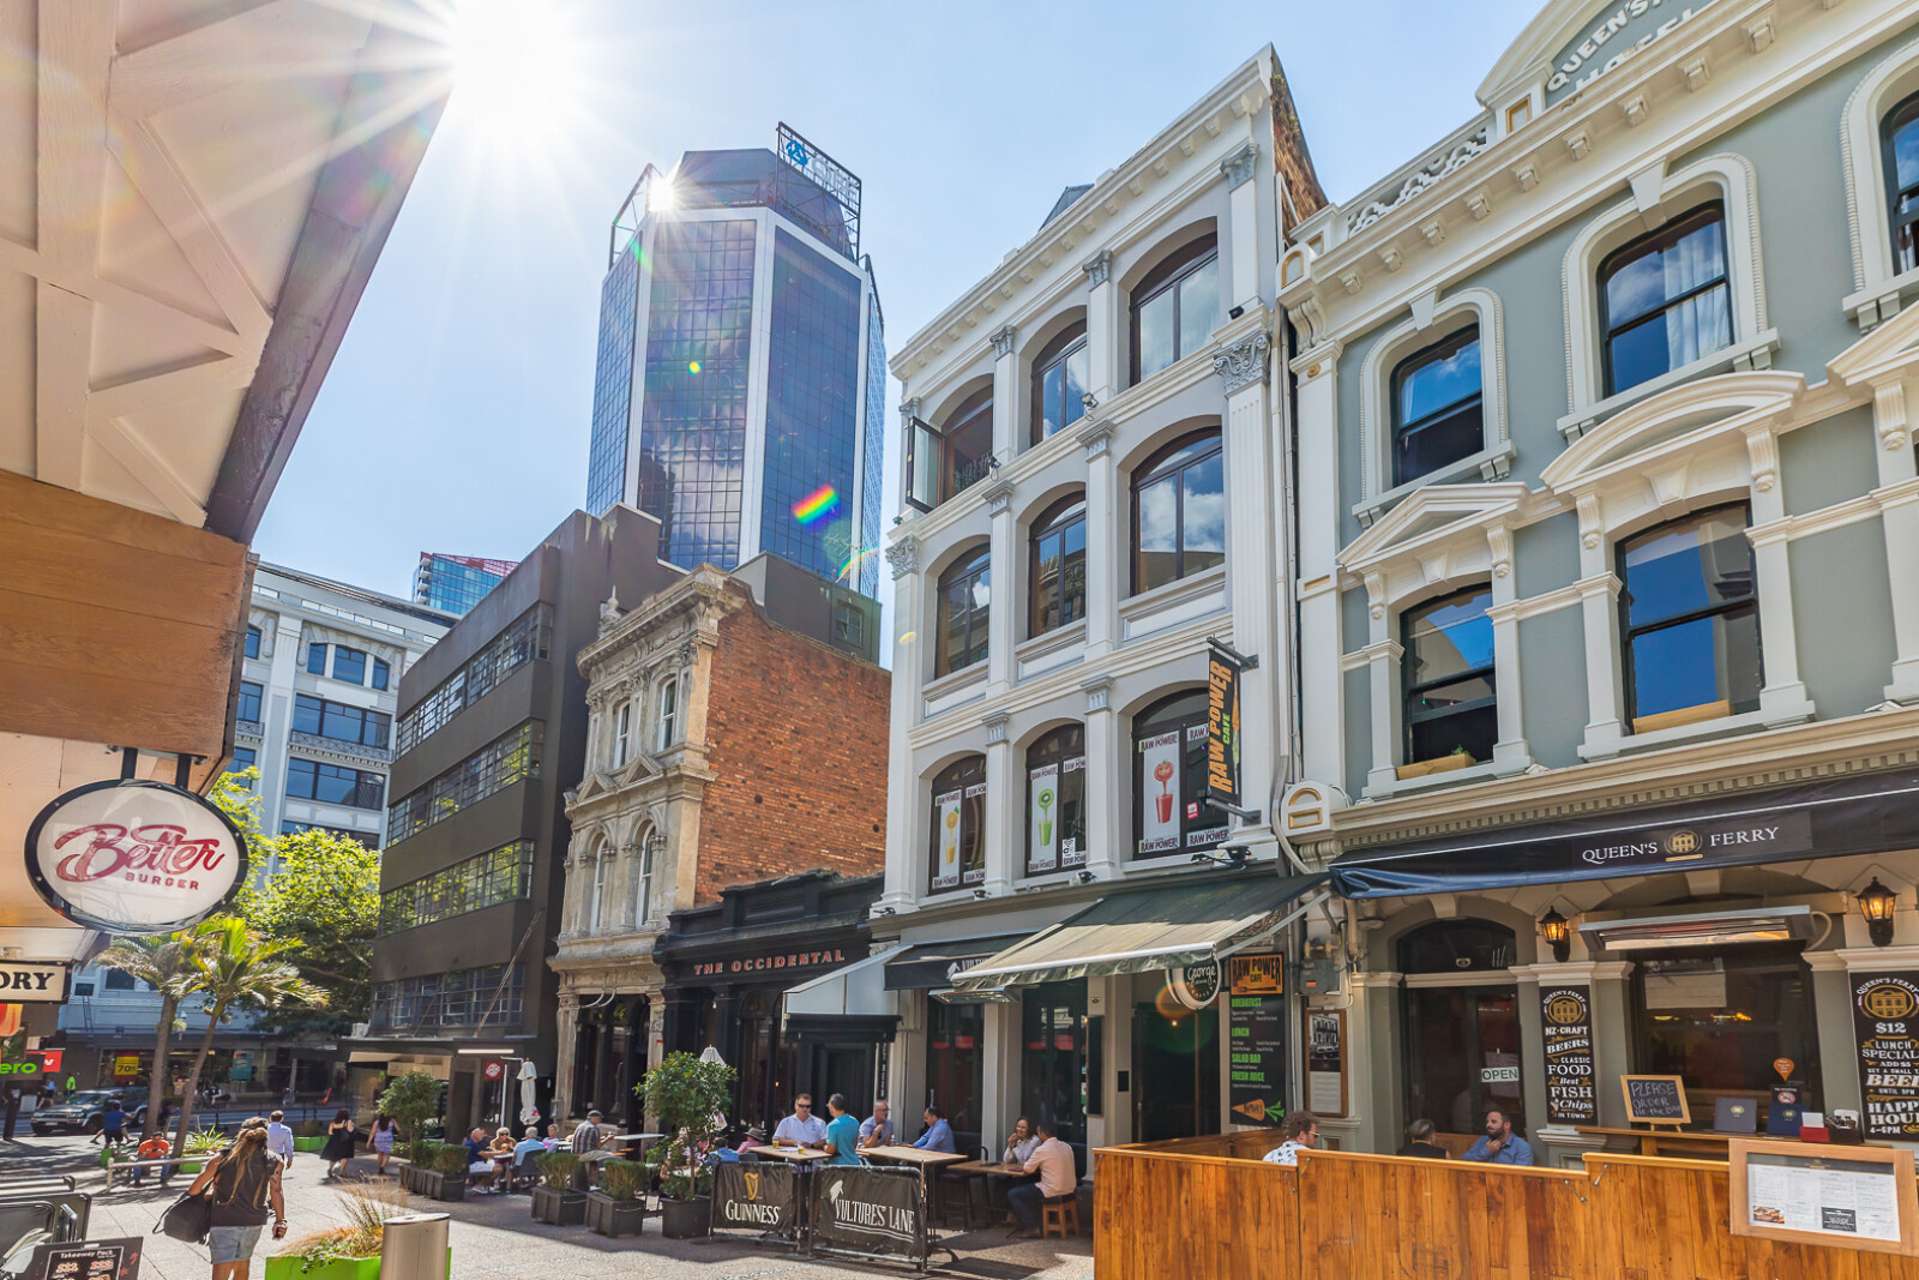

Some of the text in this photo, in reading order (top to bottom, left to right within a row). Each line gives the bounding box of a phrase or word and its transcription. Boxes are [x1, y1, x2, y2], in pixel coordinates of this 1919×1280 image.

[1547, 0, 1651, 92] QUEEN'S
[1190, 726, 1206, 740] RAW
[1209, 660, 1233, 793] RAW POWER
[1222, 713, 1231, 745] CAFE
[1190, 834, 1205, 845] RAW
[1582, 826, 1779, 865] QUEEN'S FERRY
[54, 823, 225, 882] Better
[125, 872, 199, 890] BURGER
[694, 949, 845, 976] THE OCCIDENTAL
[1546, 1039, 1590, 1054] BEERS
[1875, 1040, 1912, 1050] LUNCH
[1482, 1069, 1519, 1081] OPEN
[1547, 1064, 1592, 1076] FOOD
[1550, 1086, 1593, 1098] FISH
[1630, 1081, 1675, 1096] PLEASE
[1559, 1099, 1593, 1111] Chips
[1867, 1101, 1919, 1113] HAPP
[1869, 1113, 1919, 1125] HOU
[724, 1199, 781, 1225] GUINNESS
[889, 1206, 915, 1234] LANE
